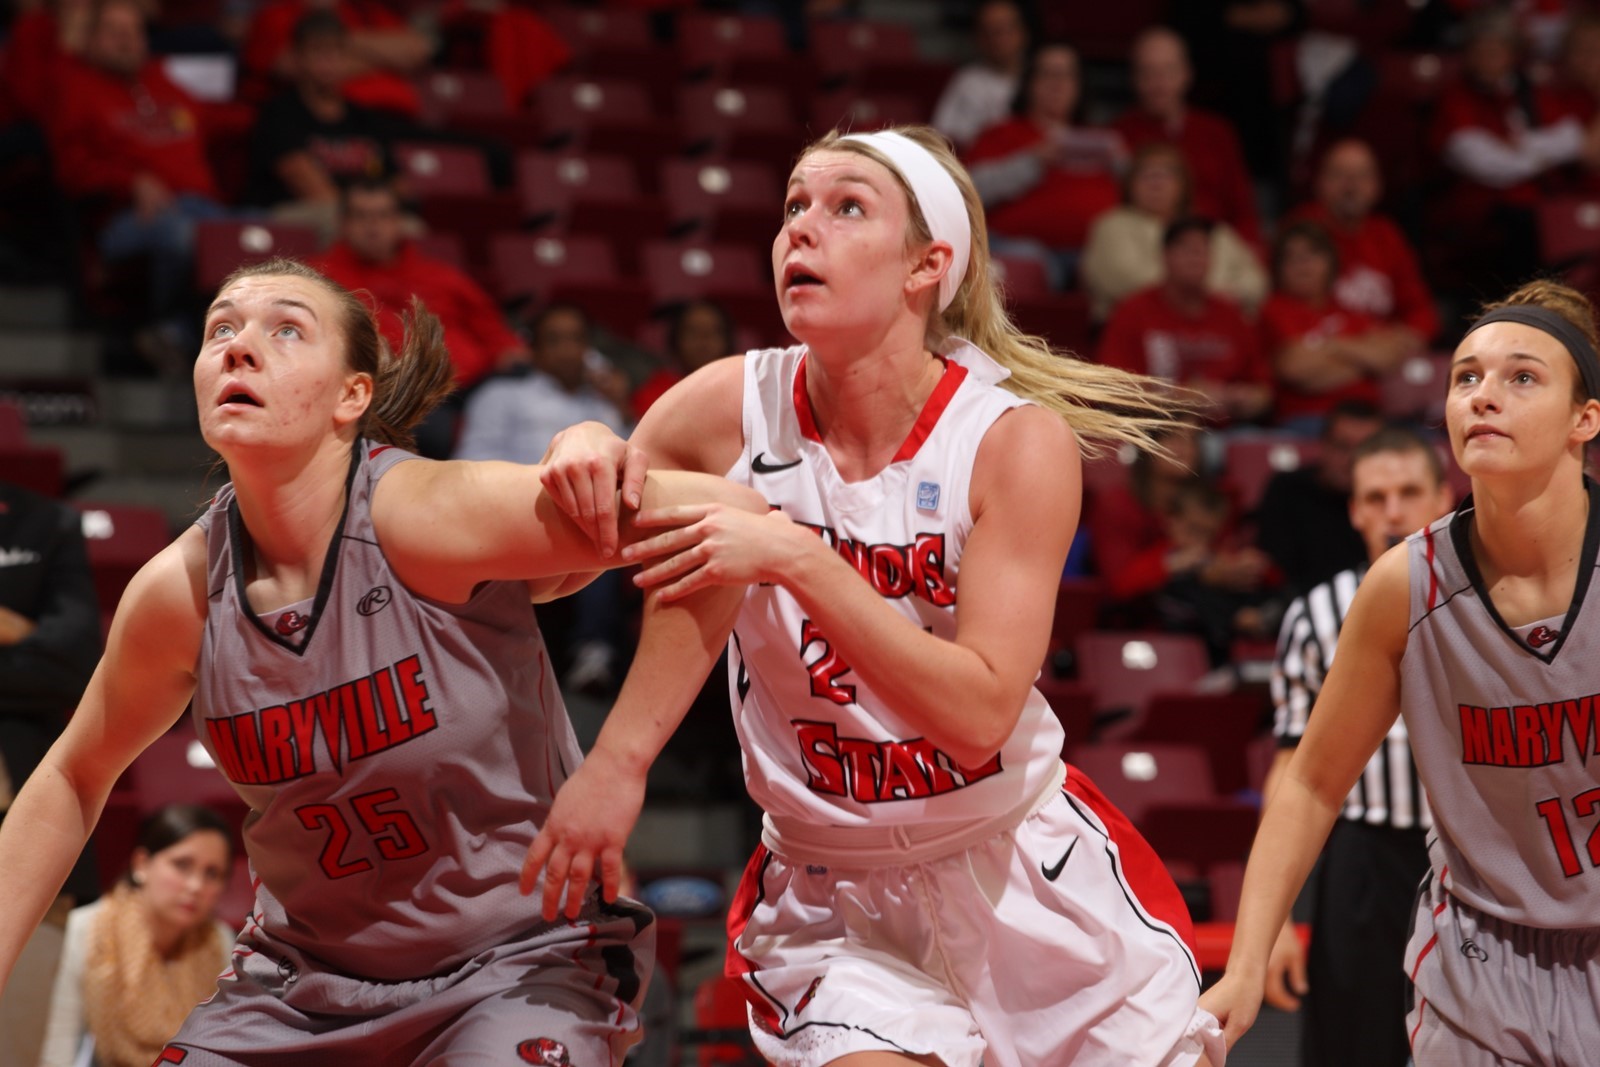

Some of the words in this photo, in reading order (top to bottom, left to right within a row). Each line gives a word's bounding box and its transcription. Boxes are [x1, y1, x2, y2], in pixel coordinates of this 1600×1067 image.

[205, 653, 438, 785] MARYVILLE
[790, 719, 1004, 803] STAT
[294, 787, 430, 880] 25
